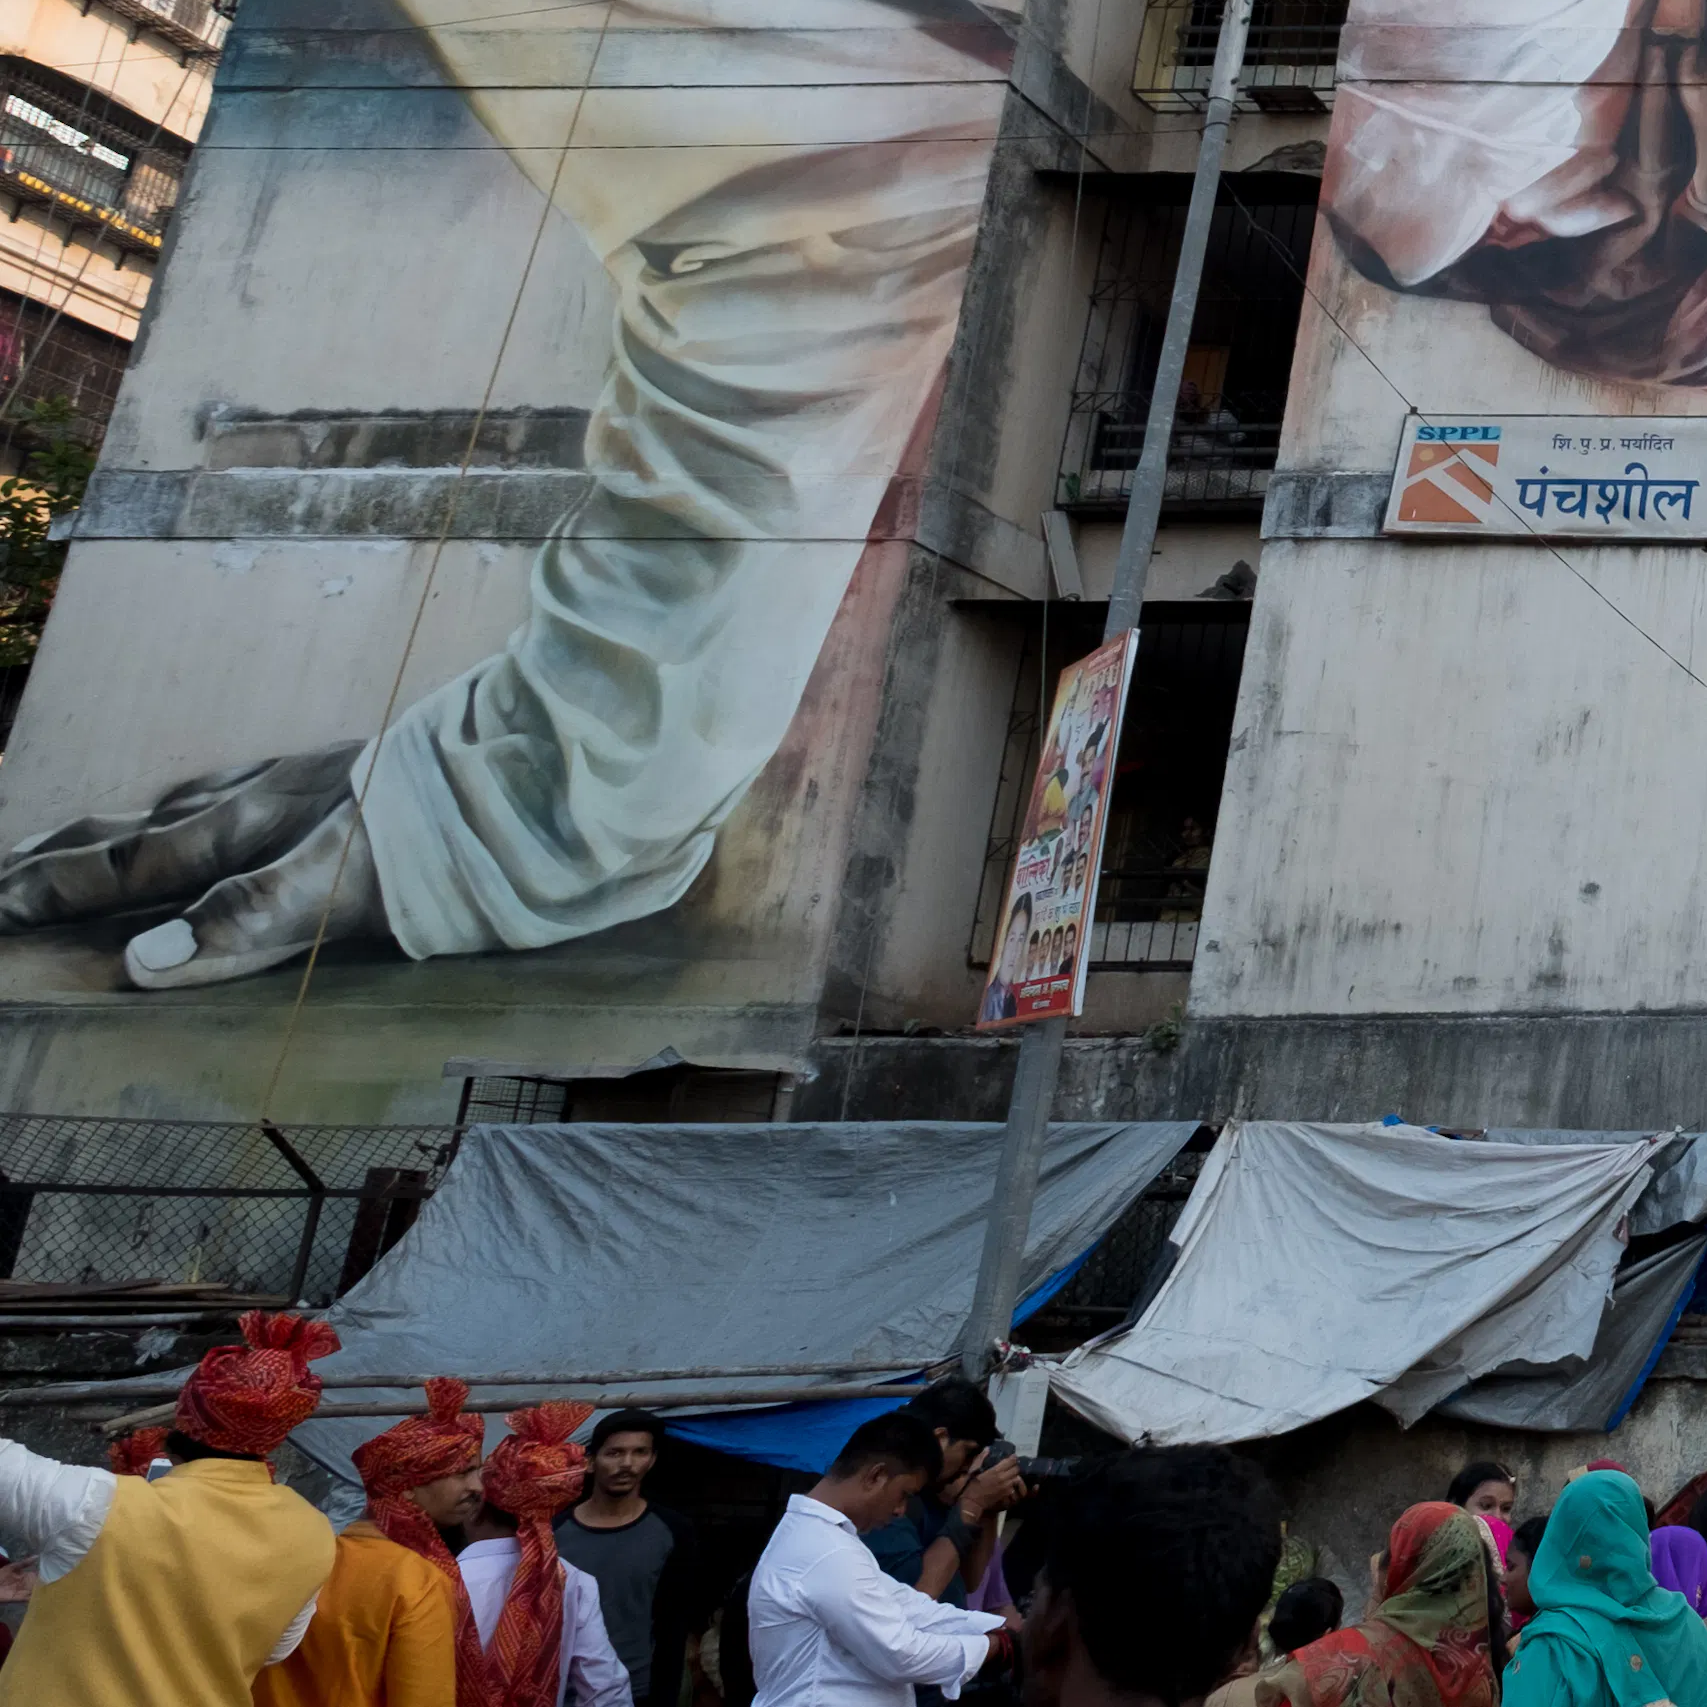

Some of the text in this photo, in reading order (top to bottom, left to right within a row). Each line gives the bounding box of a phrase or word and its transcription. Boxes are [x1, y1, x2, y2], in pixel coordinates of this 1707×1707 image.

[1417, 426, 1500, 441] SPPL
[1620, 433, 1675, 454] मर्यादित
[1515, 462, 1700, 525] पंचशील
